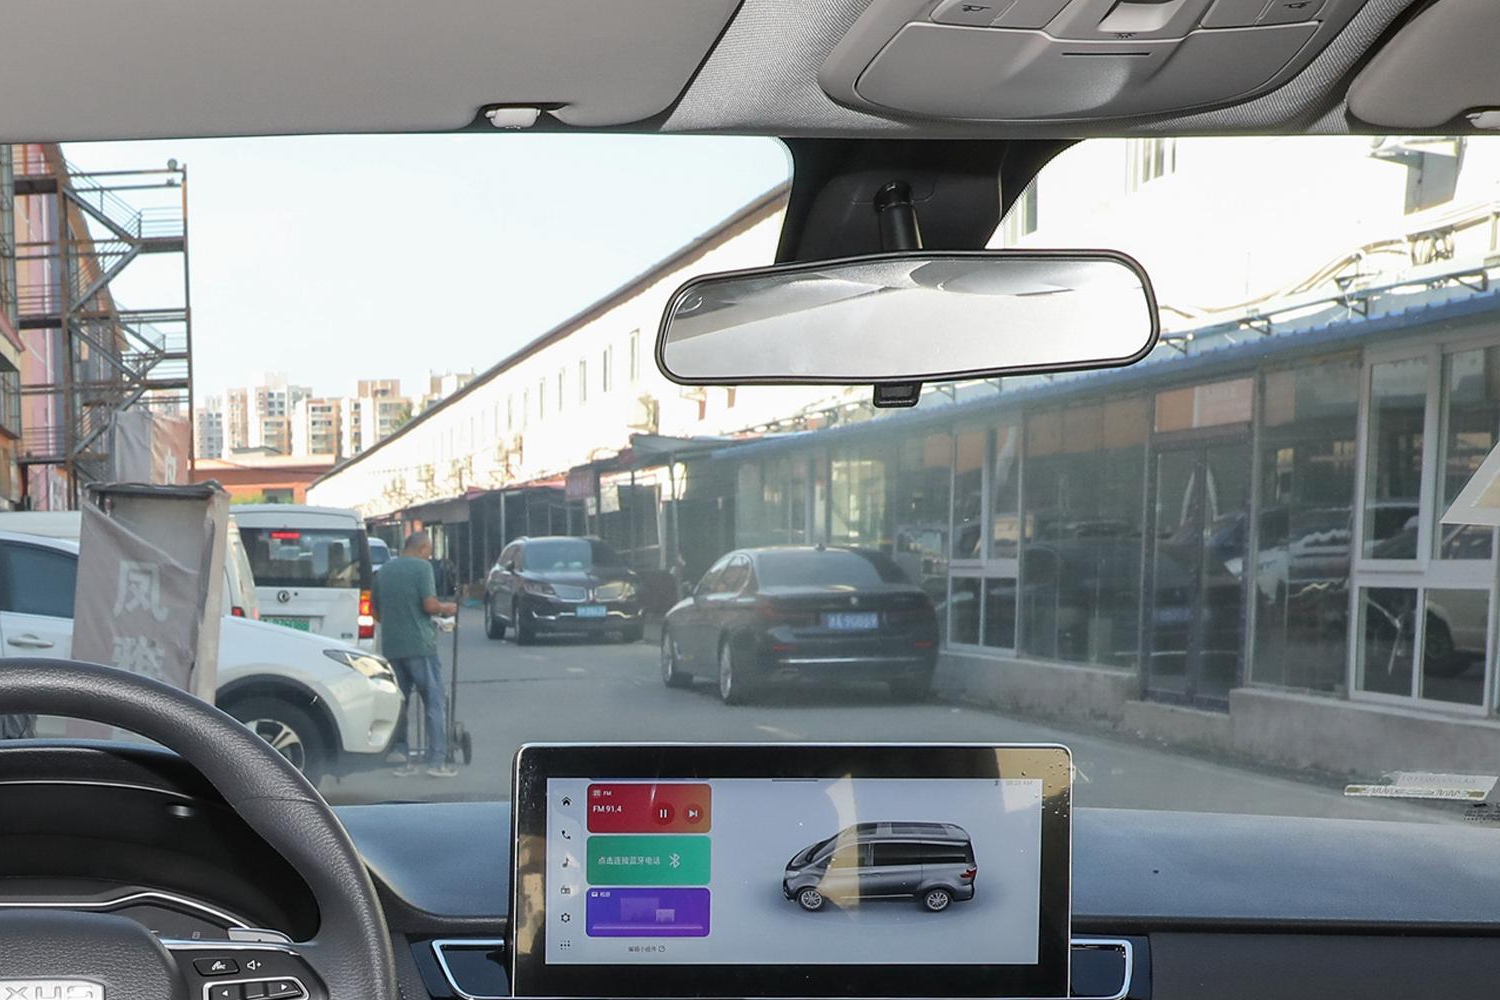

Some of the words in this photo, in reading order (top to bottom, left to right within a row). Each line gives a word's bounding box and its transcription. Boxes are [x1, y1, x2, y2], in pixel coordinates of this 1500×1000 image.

[592, 805, 605, 813] FM
[606, 805, 622, 813] 91.4
[598, 855, 661, 866] 点击连接蓝牙电话
